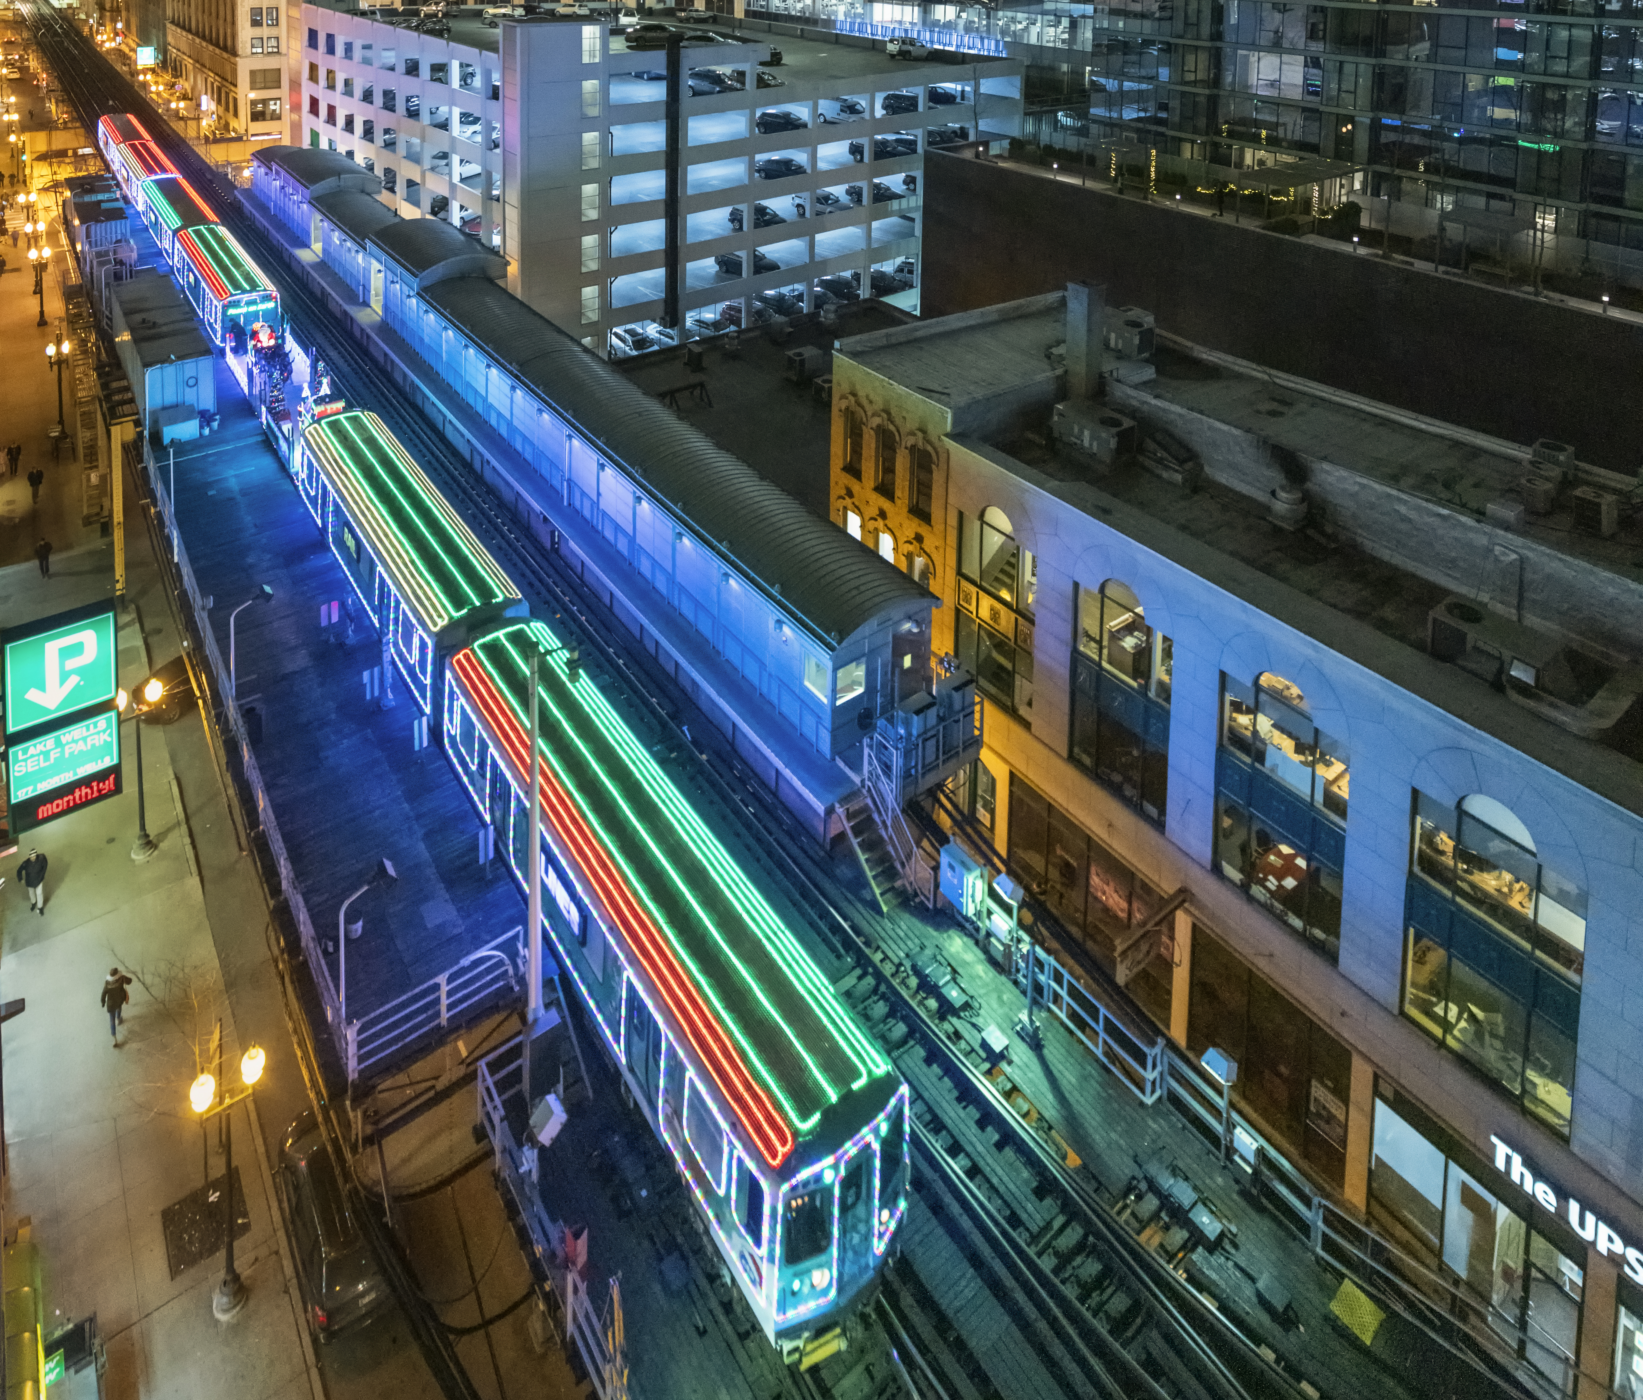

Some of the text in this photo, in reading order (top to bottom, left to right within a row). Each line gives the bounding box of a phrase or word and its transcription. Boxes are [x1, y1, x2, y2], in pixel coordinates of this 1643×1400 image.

[44, 629, 97, 709] P
[14, 729, 112, 776] SELF PARK
[18, 719, 107, 760] LAKE WELLS
[16, 756, 111, 799] 177 NORTH WELLS
[1490, 1134, 1643, 1285] The UPS
